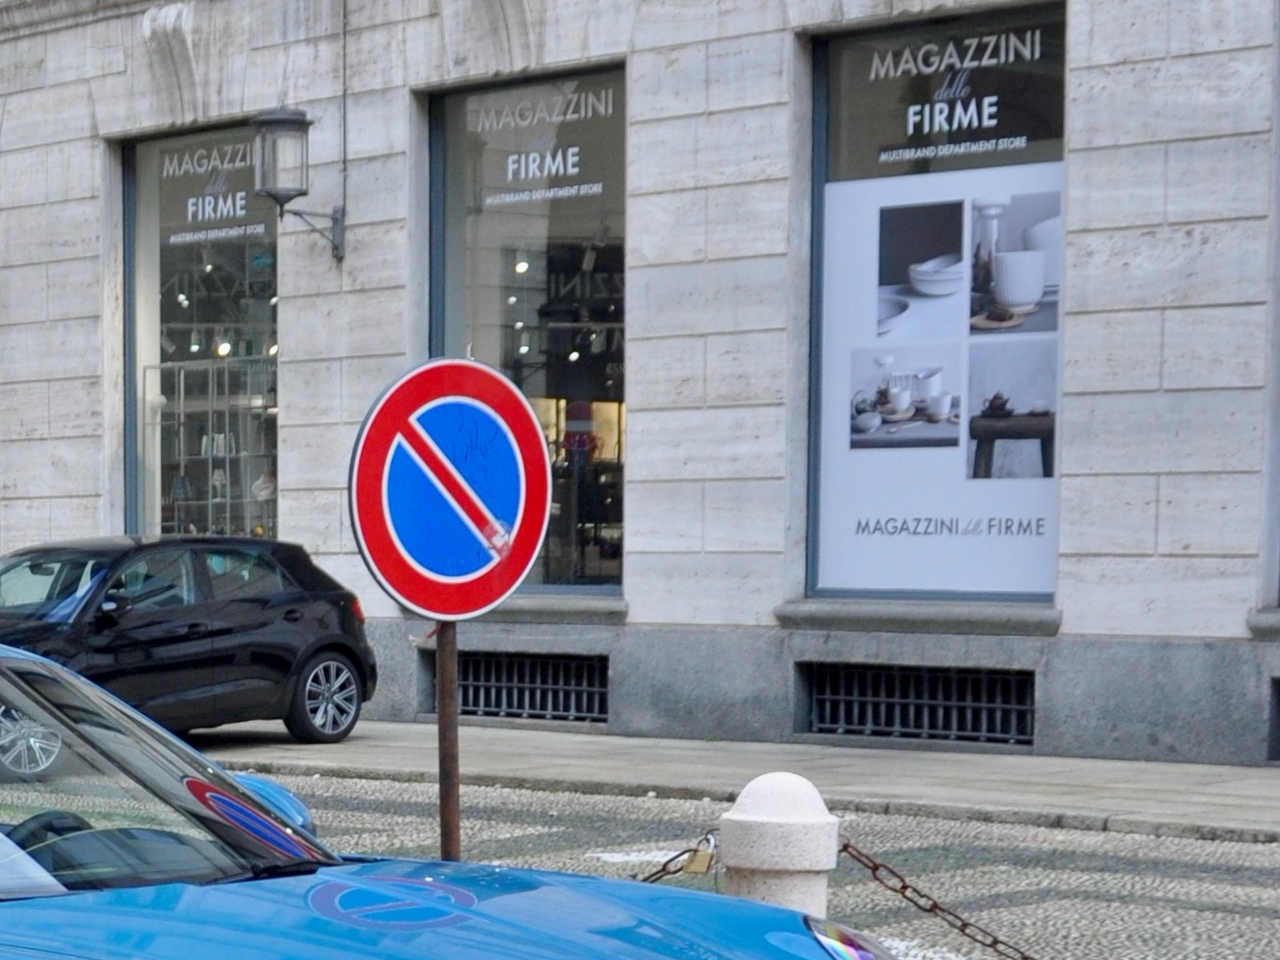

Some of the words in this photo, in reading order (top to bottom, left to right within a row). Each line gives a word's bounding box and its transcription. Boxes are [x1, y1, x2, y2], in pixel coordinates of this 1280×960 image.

[869, 29, 1041, 80] MAGAZZINI
[933, 70, 971, 100] delle
[477, 88, 614, 132] MAGAZZINI
[906, 96, 999, 137] FIRME
[162, 141, 257, 179] MAGAZZI
[506, 146, 580, 182] FIRME
[878, 147, 937, 163] MULTIBRAND
[938, 139, 997, 155] DEPARTMENT
[997, 136, 1028, 149] STORE
[187, 191, 247, 223] FIRME
[855, 517, 960, 536] MAGAZZINI
[987, 517, 1046, 536] FIRME
